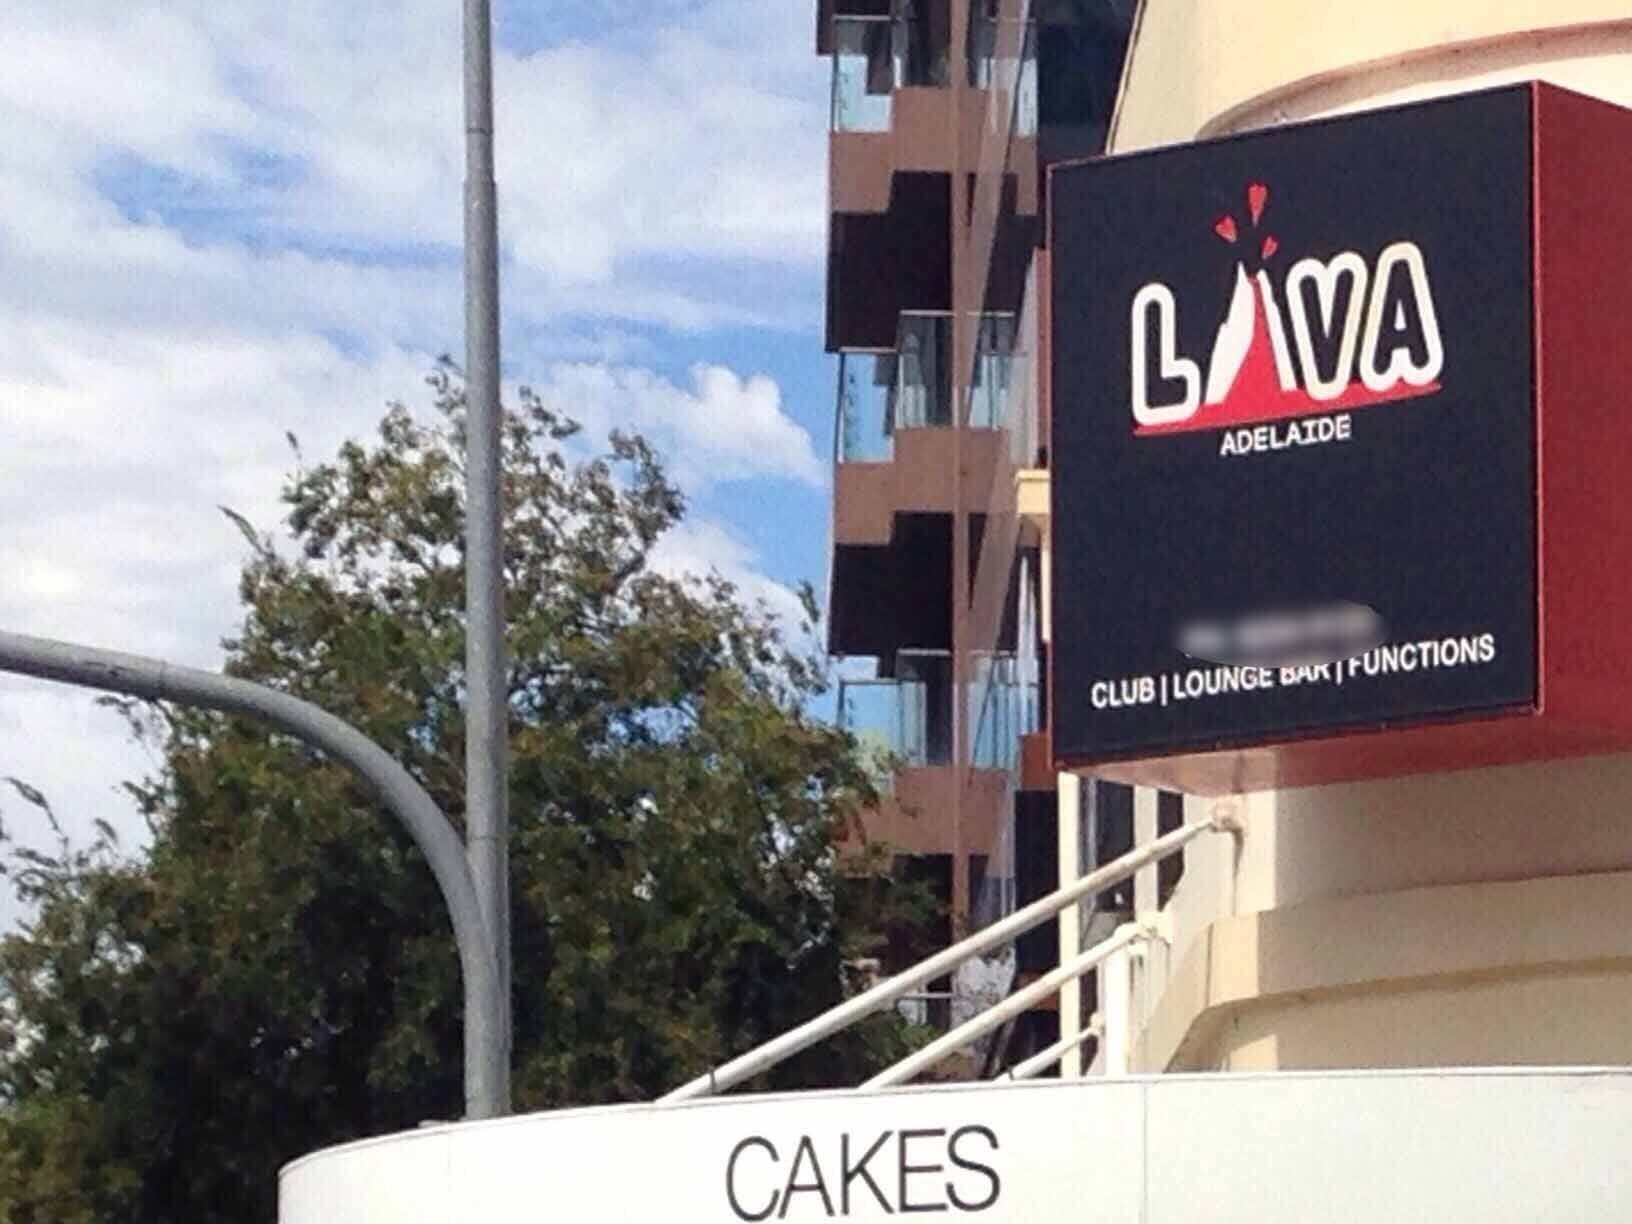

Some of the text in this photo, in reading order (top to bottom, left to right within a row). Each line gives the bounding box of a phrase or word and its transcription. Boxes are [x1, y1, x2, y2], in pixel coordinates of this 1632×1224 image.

[1131, 241, 1444, 425] LAVA
[1219, 413, 1352, 456] ADELAIDE
[1091, 673, 1155, 709] CLUB
[1172, 663, 1274, 700] LOUNGE
[1348, 633, 1496, 676] FUNCTIONS
[726, 1124, 1001, 1223] CAKES
